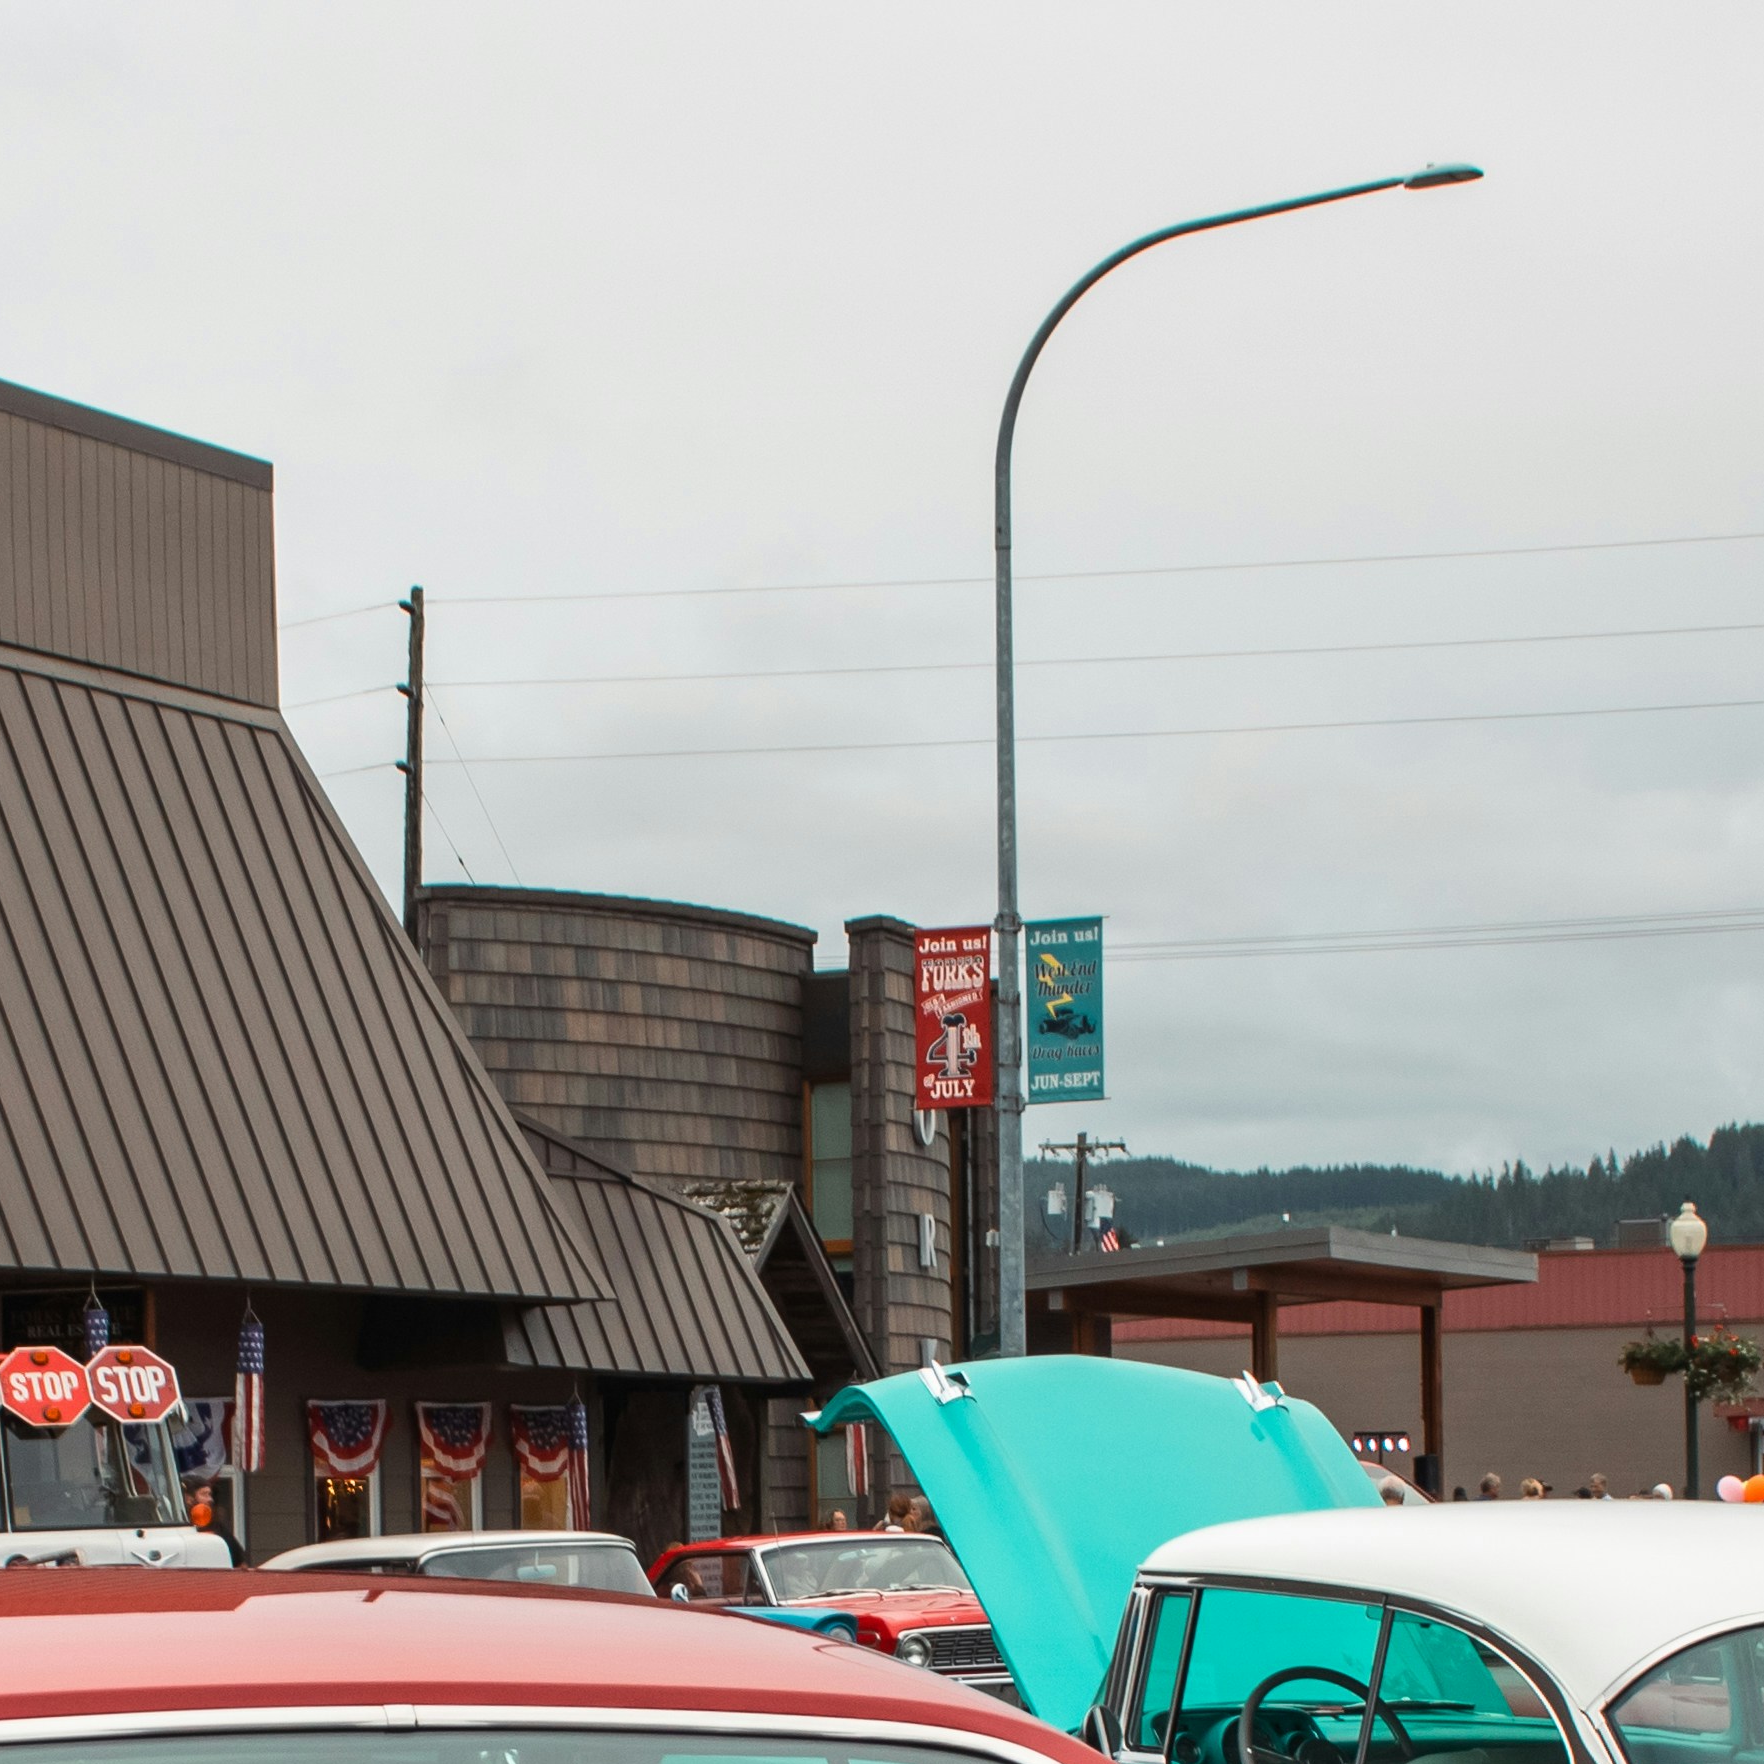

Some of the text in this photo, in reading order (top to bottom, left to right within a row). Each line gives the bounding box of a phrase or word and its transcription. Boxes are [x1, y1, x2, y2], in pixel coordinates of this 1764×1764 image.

[919, 934, 987, 954] Join us!
[1030, 926, 1099, 946] Join us!
[921, 955, 984, 993] FORKS
[930, 1079, 975, 1099] JULY
[1030, 1071, 1101, 1091] JUN-SEPT
[9, 1370, 79, 1402] STOP
[98, 1365, 166, 1402] STOP
